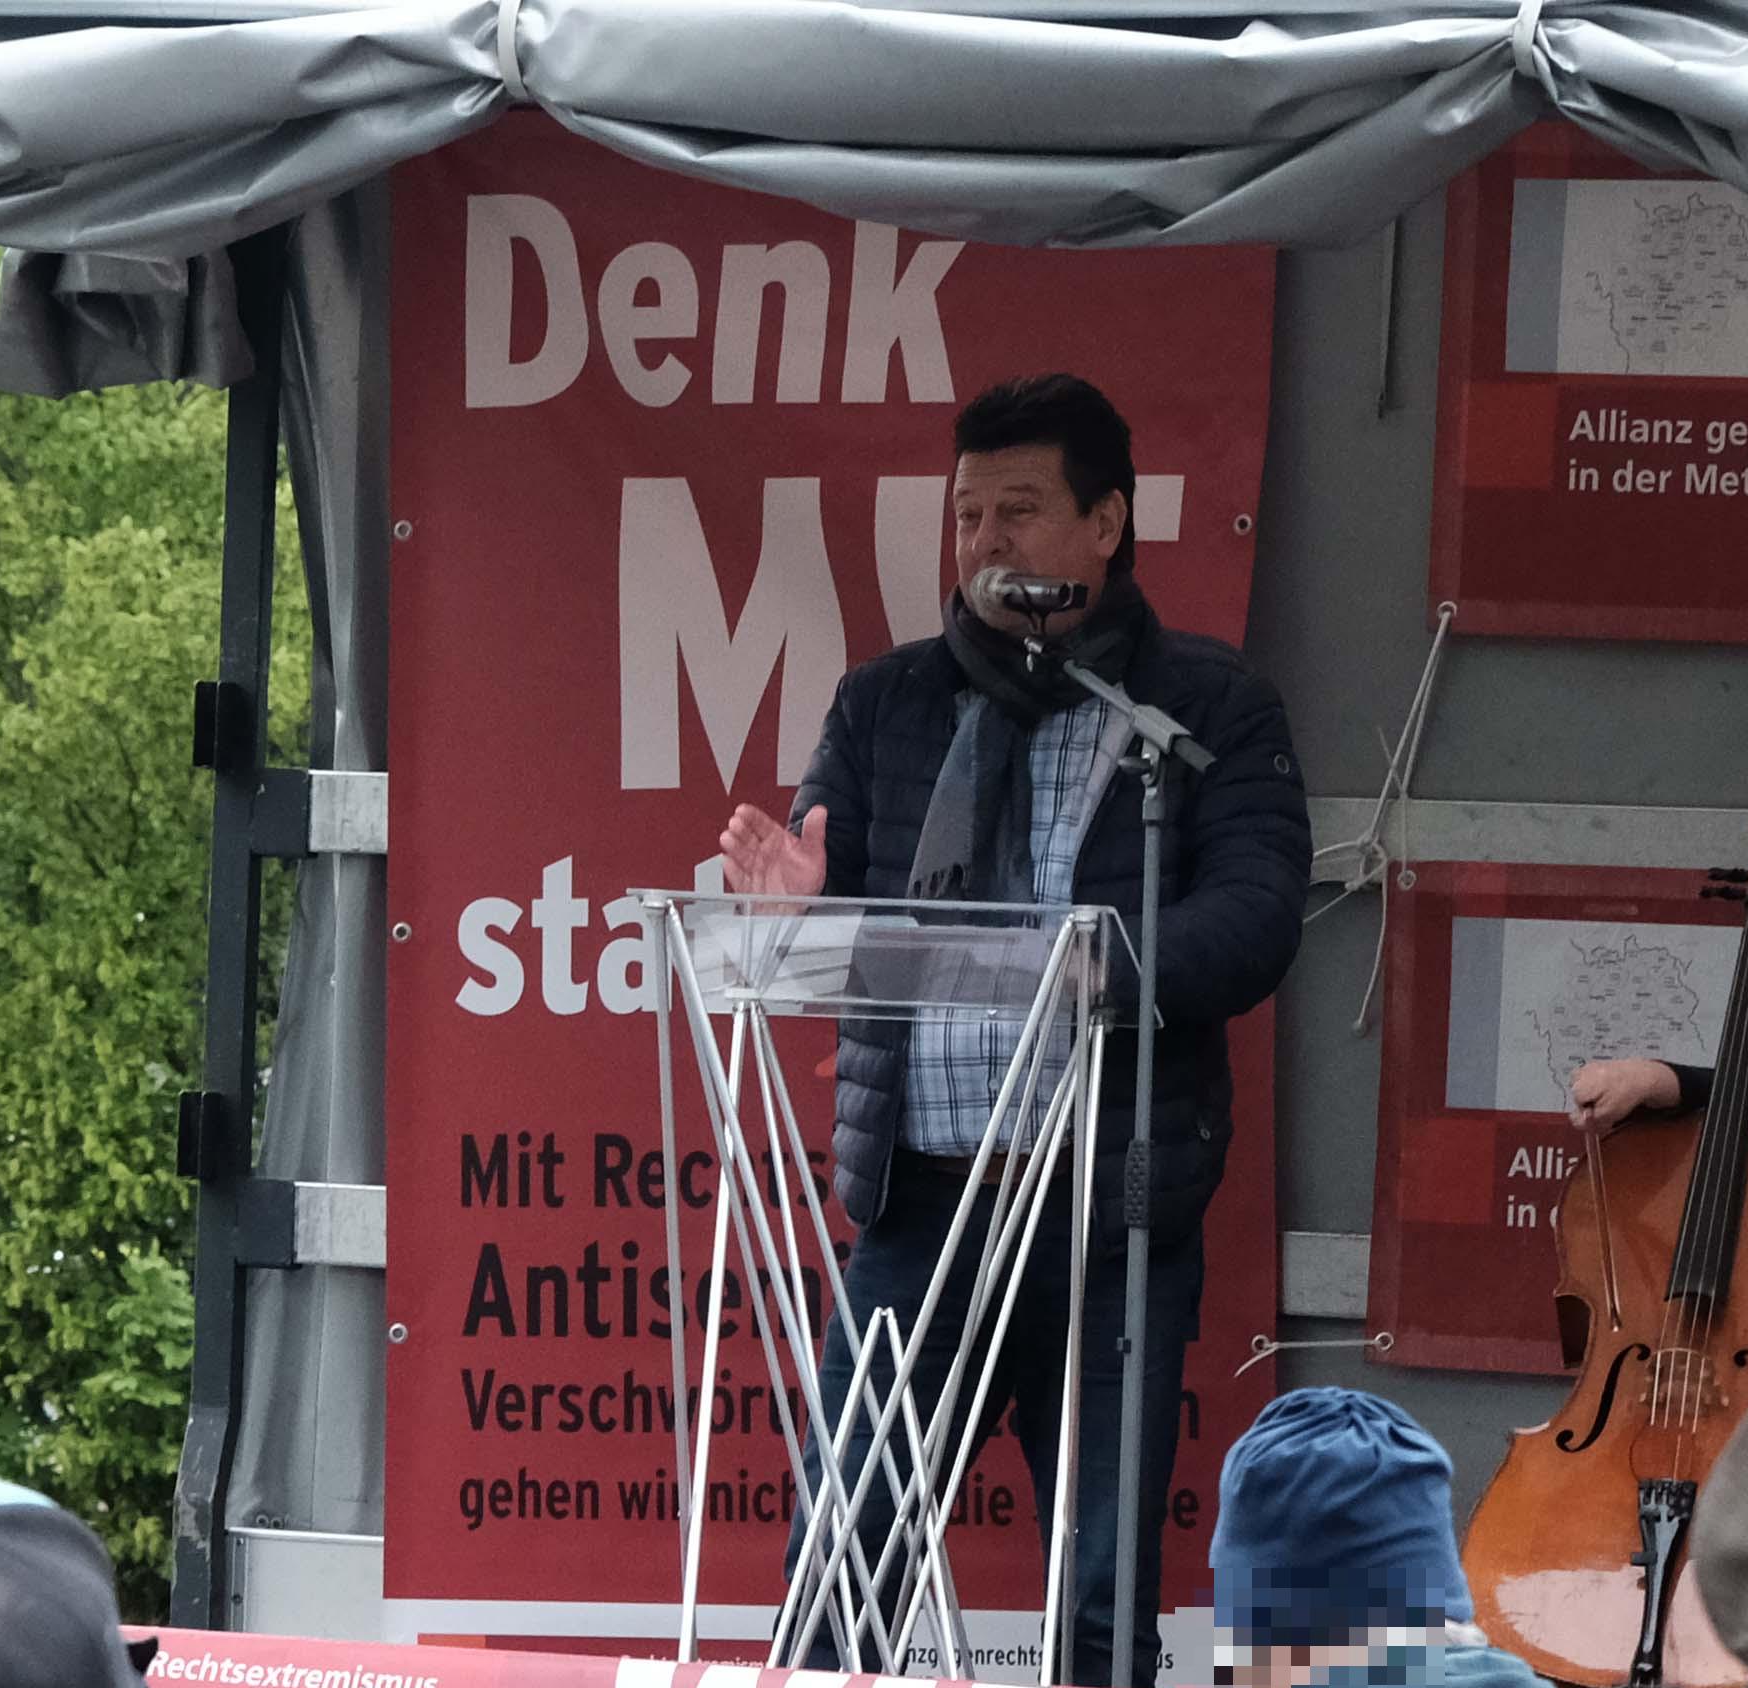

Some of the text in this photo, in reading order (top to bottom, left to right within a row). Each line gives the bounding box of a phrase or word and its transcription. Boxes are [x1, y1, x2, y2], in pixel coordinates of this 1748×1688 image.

[464, 194, 966, 409] Denk
[1568, 409, 1693, 445] Allianz
[1567, 459, 1600, 493] in
[1612, 461, 1672, 493] der
[619, 475, 1186, 796] MI
[460, 1130, 565, 1208] Mit
[1507, 1194, 1536, 1229] in
[459, 1466, 600, 1531] gehen
[709, 1469, 799, 1523] nich
